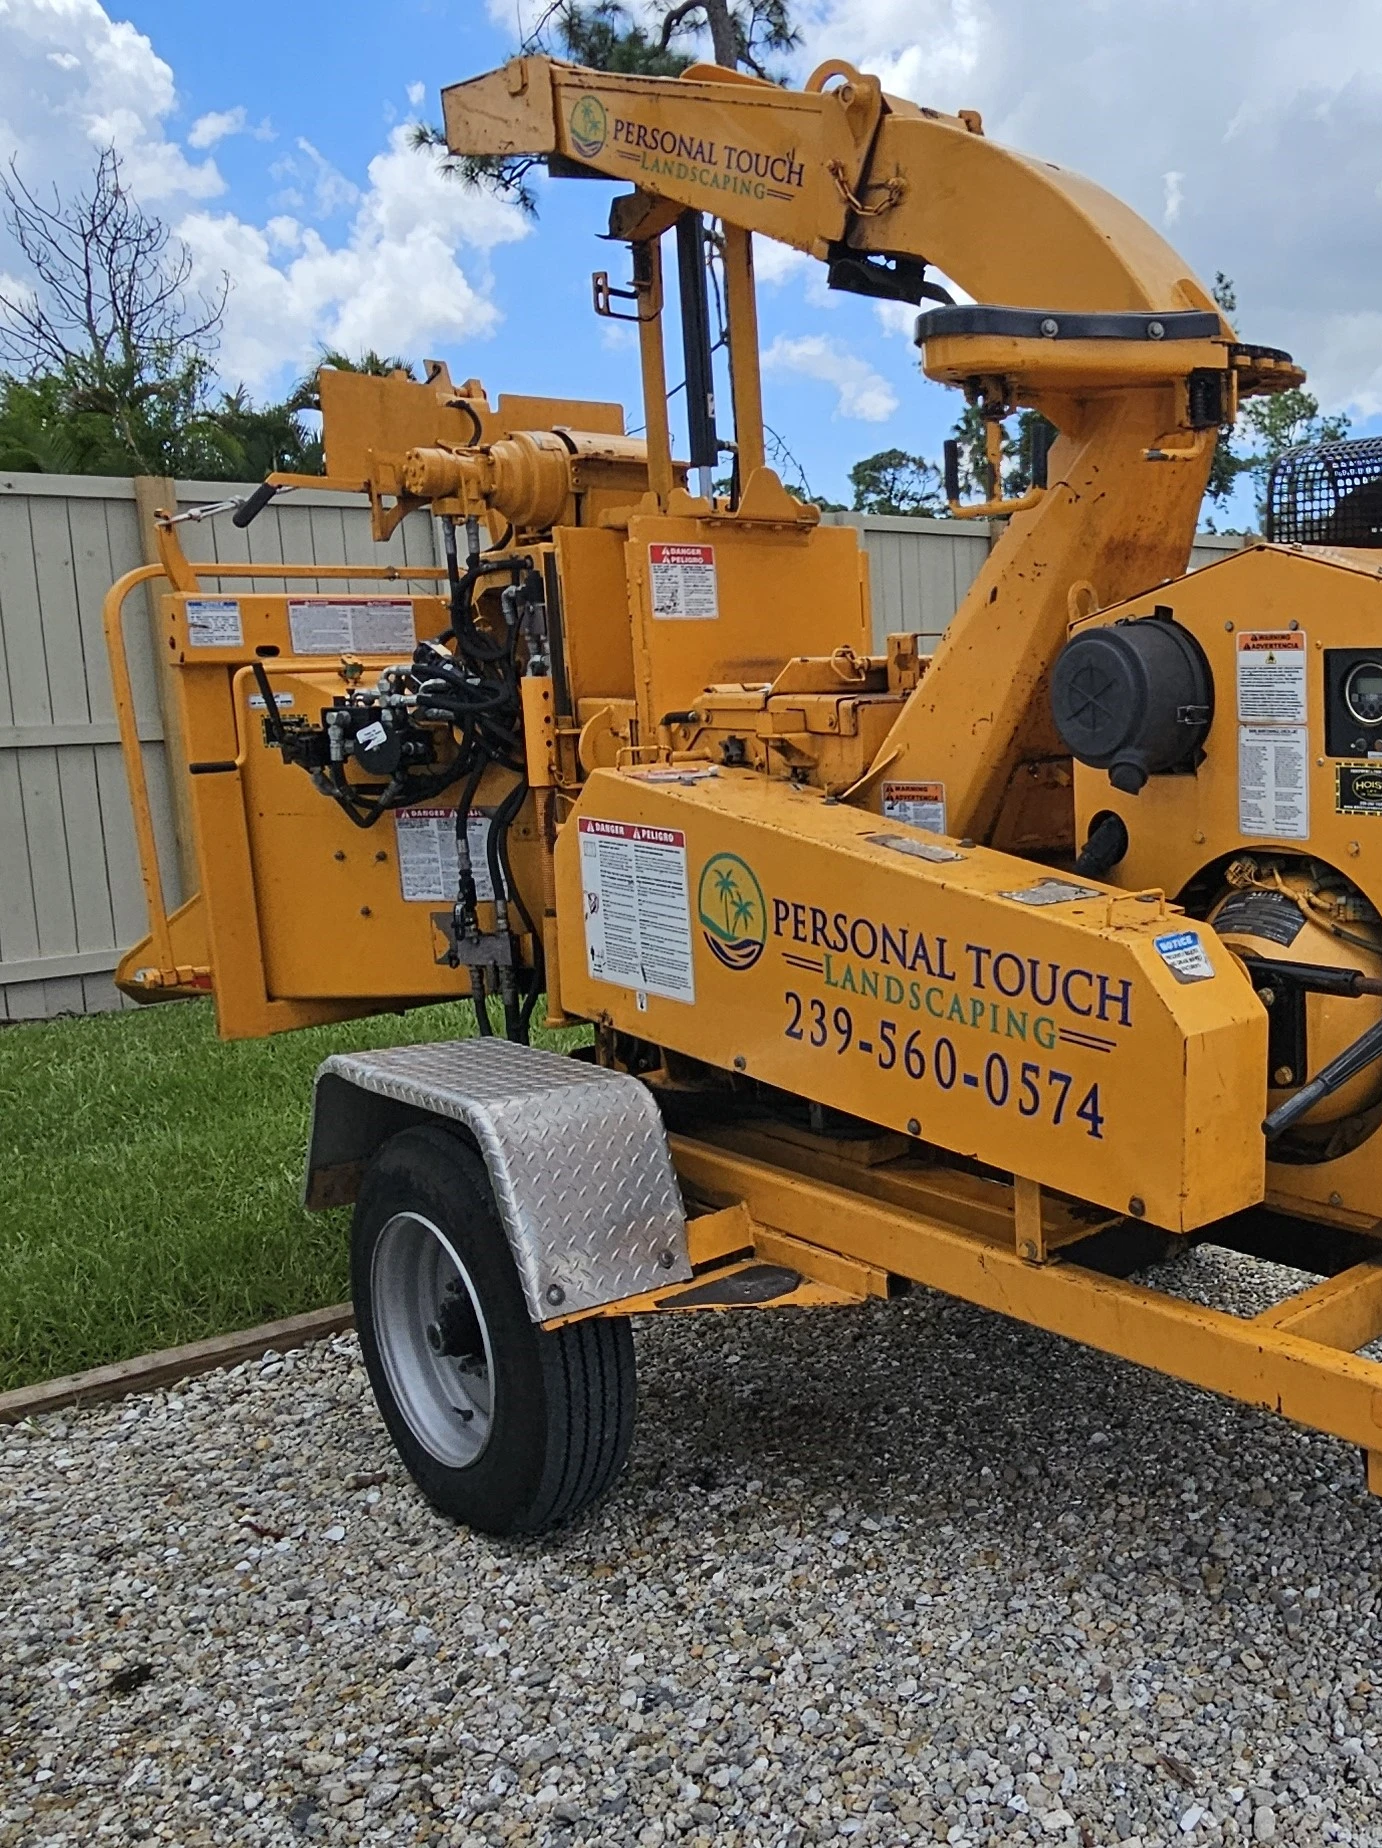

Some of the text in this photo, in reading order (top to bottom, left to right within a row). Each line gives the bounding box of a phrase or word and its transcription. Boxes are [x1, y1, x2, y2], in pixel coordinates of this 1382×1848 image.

[613, 118, 805, 187] PERSONAL TOUCH
[640, 151, 768, 200] LANDSCAPING
[670, 547, 702, 555] DANGER
[411, 809, 445, 817] DANGER
[594, 821, 674, 843] DANGER PELIGRO
[772, 897, 956, 981] PERSONAL
[966, 942, 1133, 1028] TOUCH
[1159, 934, 1194, 952] NOTICE
[823, 952, 1057, 1050] LANDSCAPING
[784, 991, 1105, 1139] 239-560-0574
